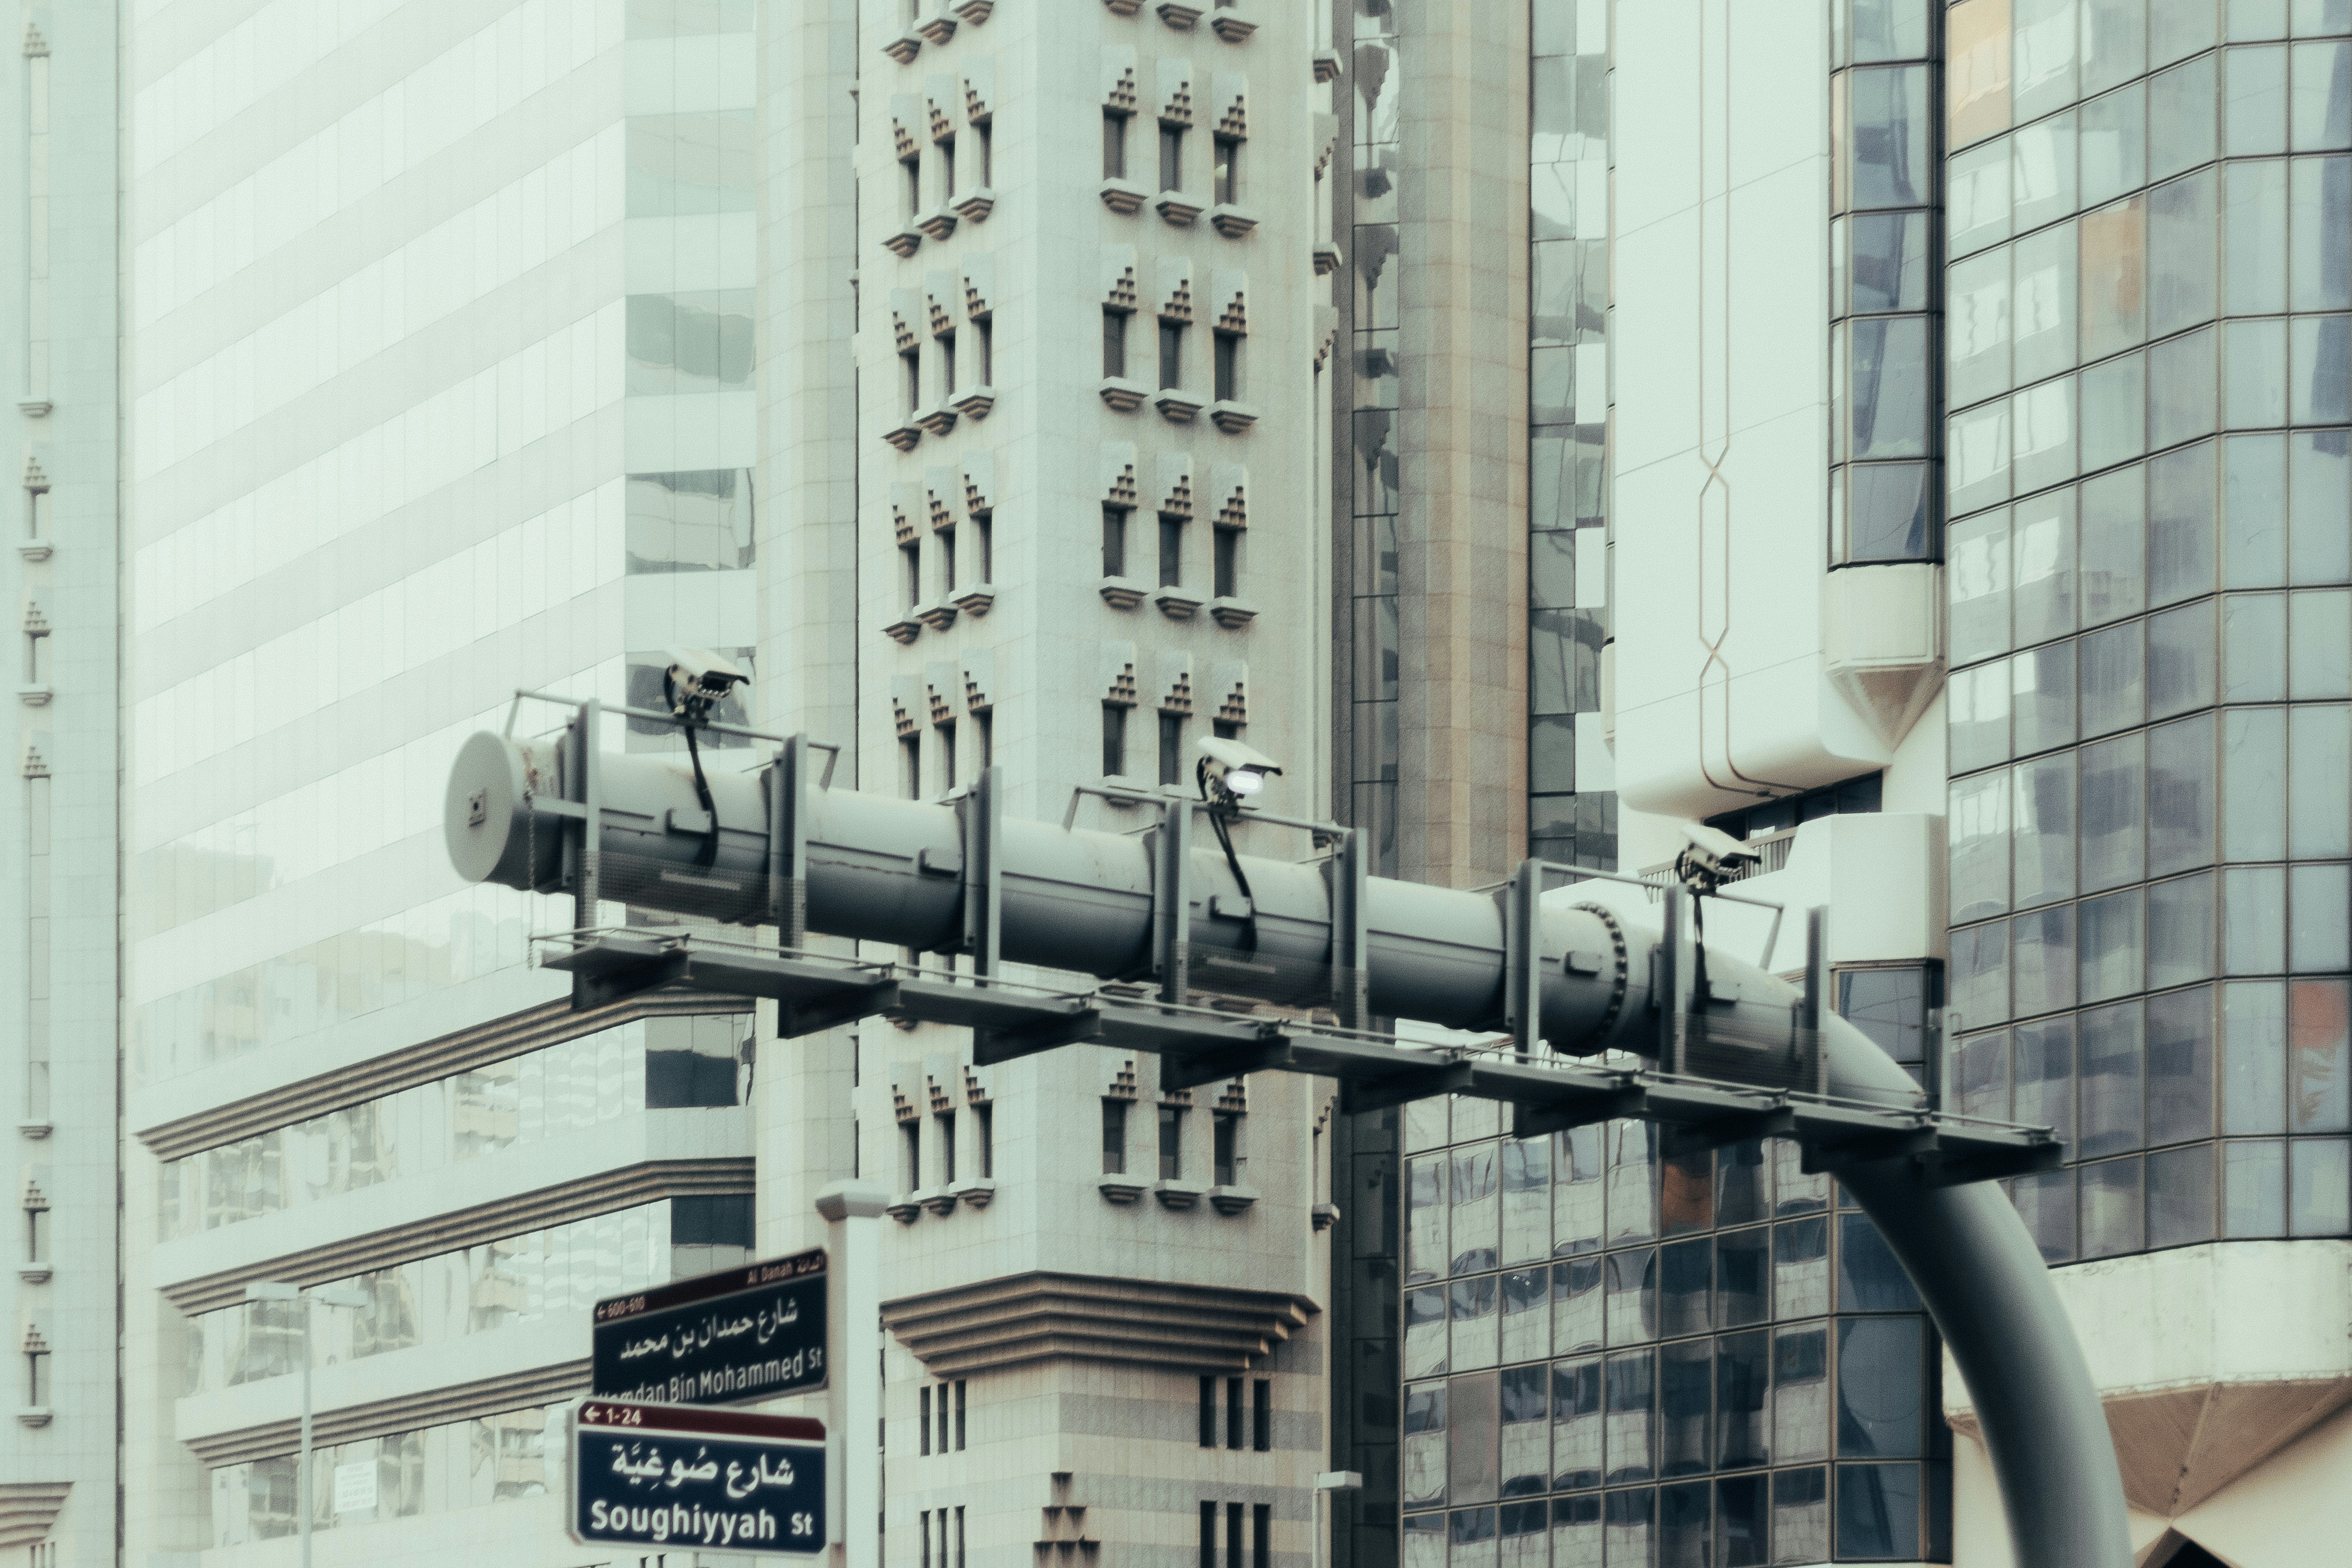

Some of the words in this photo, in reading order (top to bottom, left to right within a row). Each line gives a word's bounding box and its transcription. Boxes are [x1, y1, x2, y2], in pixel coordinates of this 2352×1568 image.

[672, 1323, 695, 1359] بن
[698, 1312, 754, 1348] حمدان
[757, 1297, 798, 1345] شارع
[620, 1334, 668, 1360] محمد
[670, 1372, 695, 1403] Bin
[699, 1347, 804, 1397] Mohammed
[808, 1346, 822, 1370] St
[606, 1407, 642, 1425] 1-24
[726, 1453, 795, 1499] شارع
[591, 1499, 776, 1545] Soughiyyah
[791, 1512, 814, 1536] St
